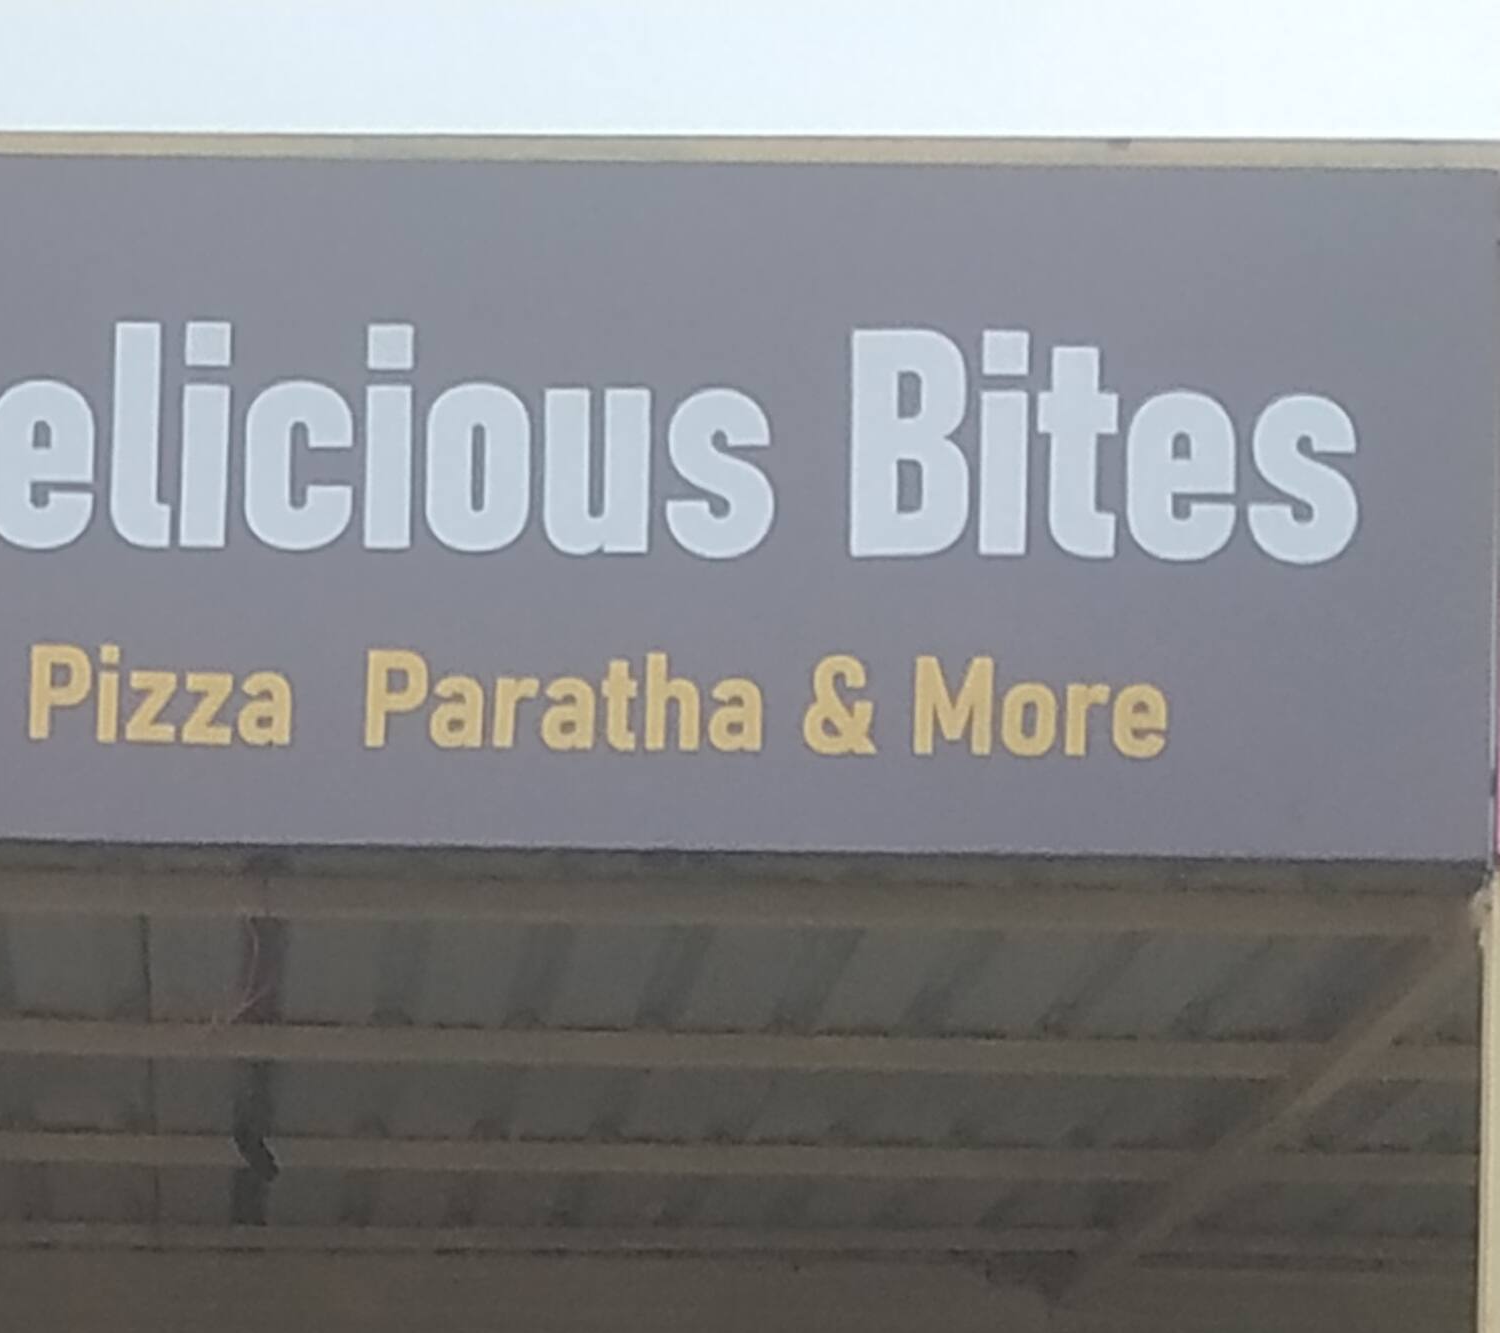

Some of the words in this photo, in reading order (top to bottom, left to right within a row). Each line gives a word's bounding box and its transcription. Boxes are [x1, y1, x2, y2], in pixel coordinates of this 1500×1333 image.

[850, 329, 1359, 565] Bites
[29, 643, 293, 746] Pizza
[364, 648, 764, 753] Paratha
[803, 654, 877, 756] &
[912, 656, 1168, 758] More
